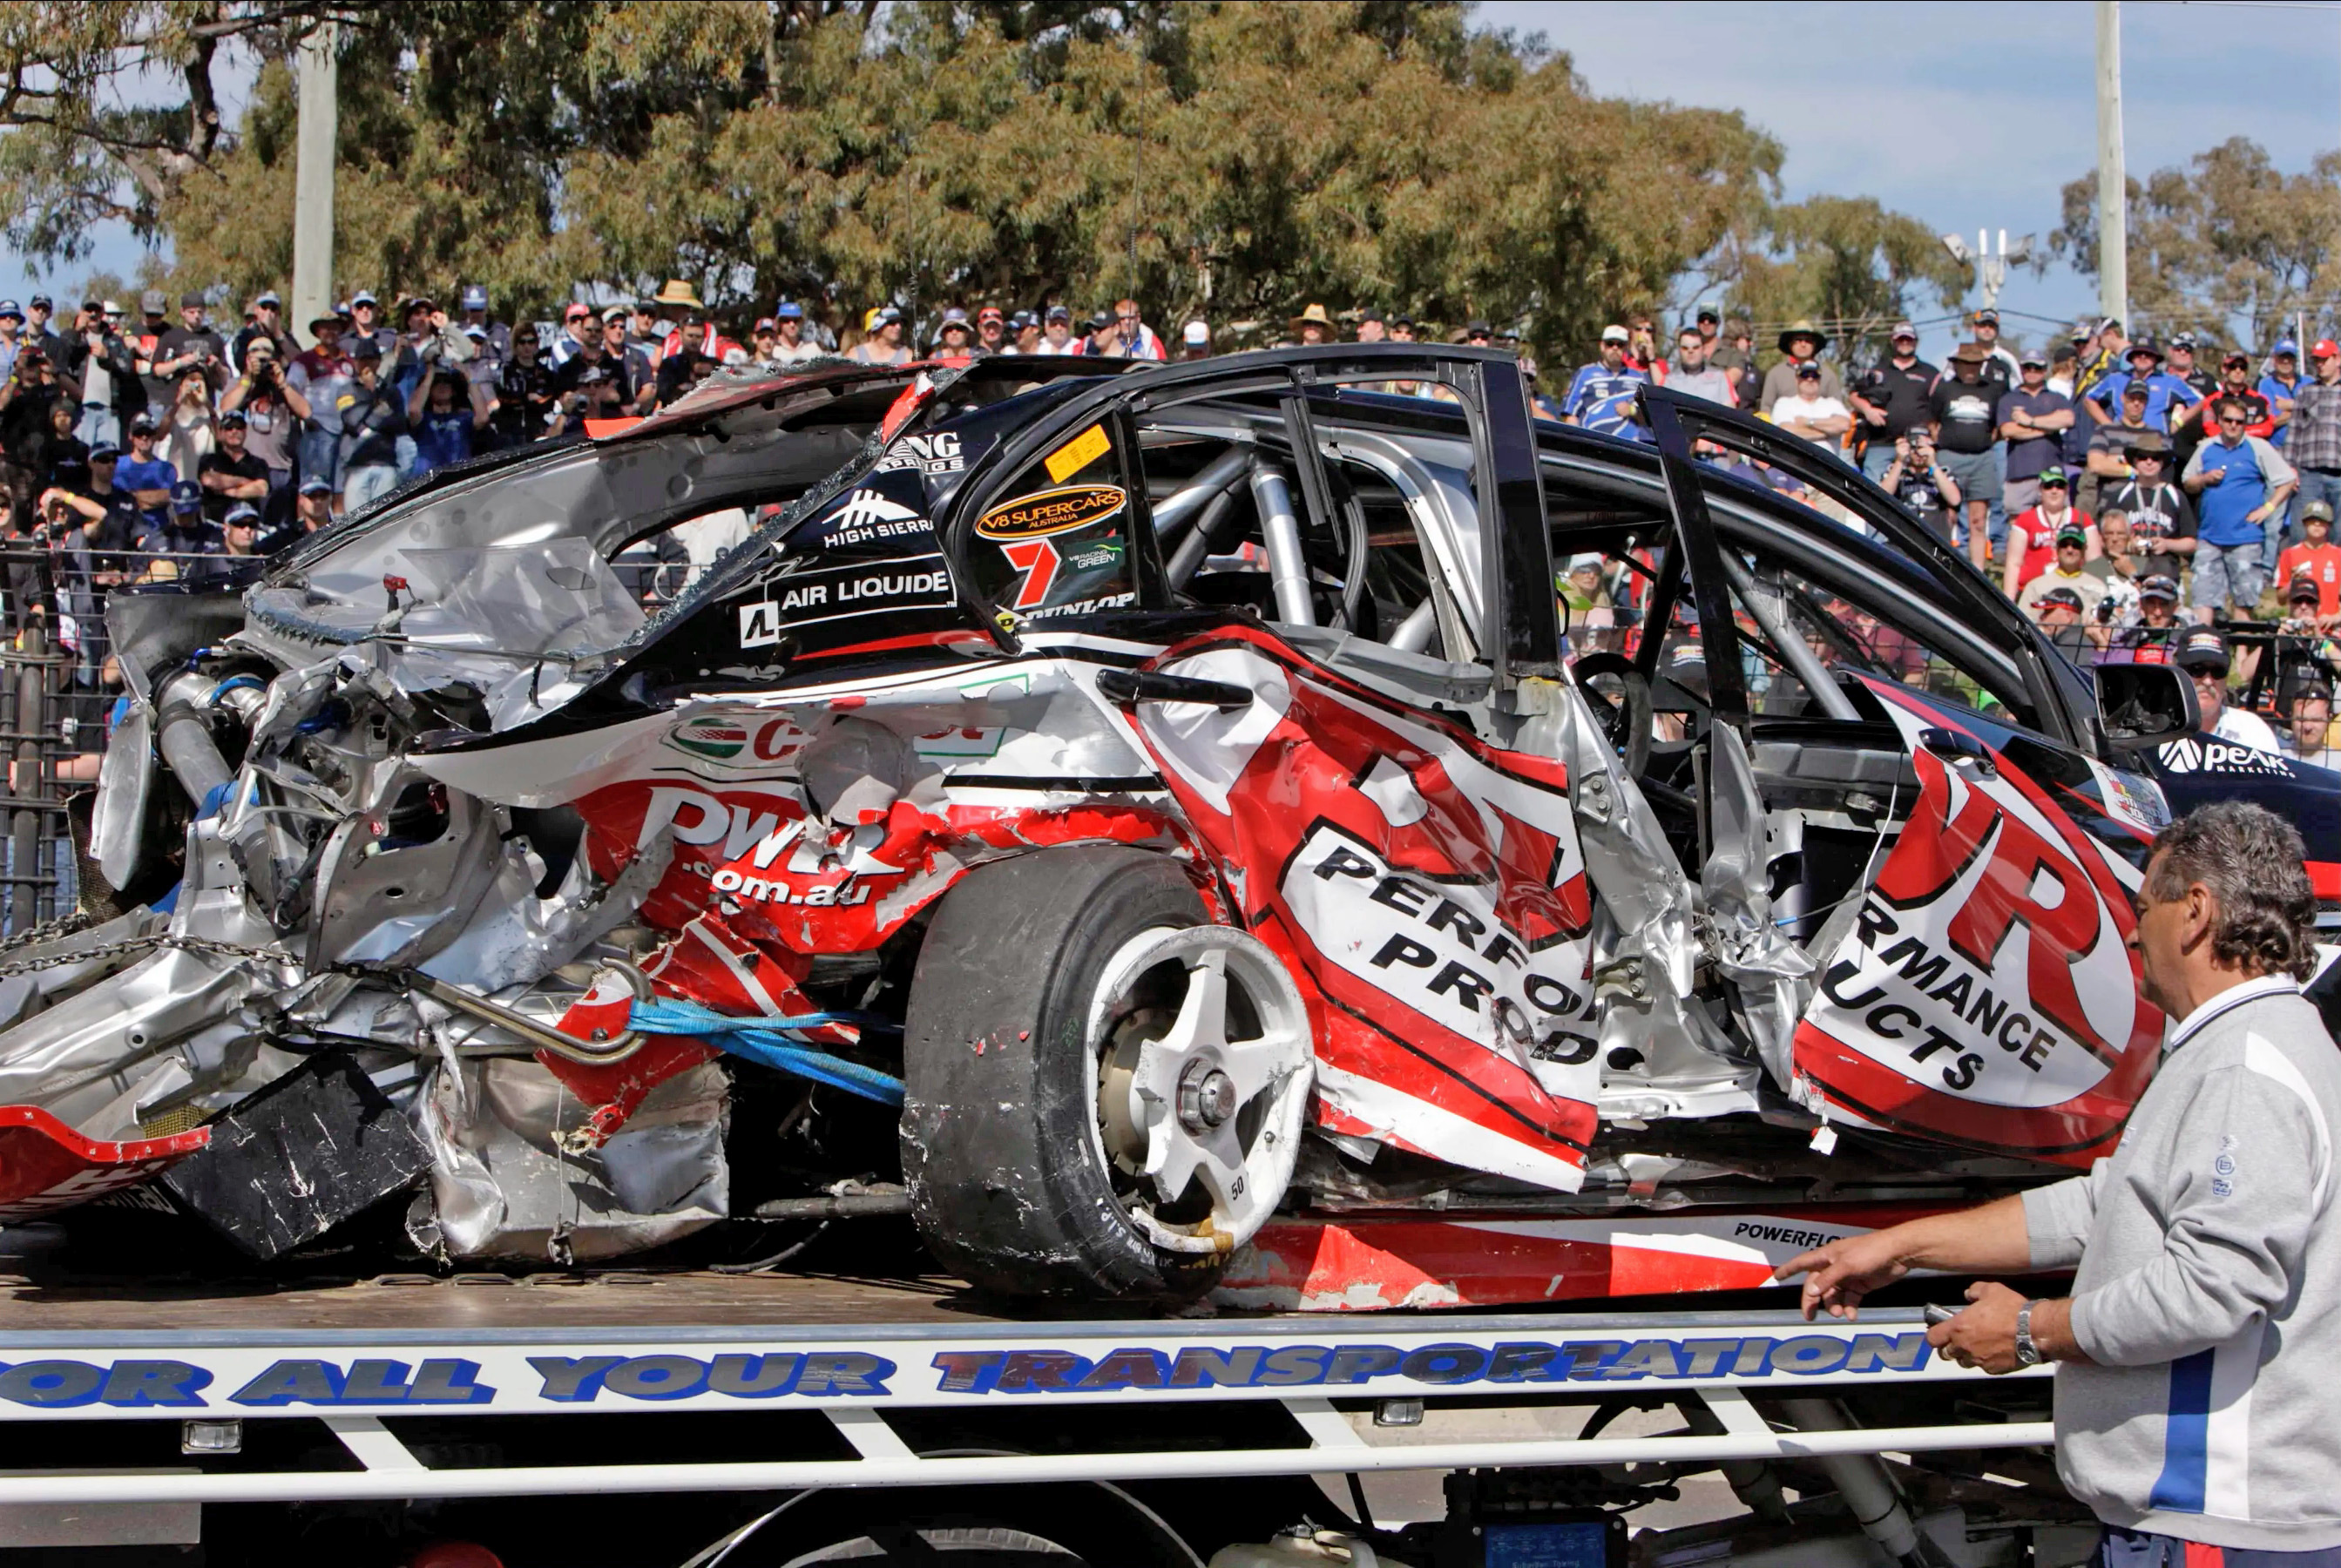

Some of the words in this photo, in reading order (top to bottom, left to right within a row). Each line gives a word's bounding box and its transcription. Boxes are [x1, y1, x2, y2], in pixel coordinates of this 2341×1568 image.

[983, 514, 1010, 530] V8
[1012, 490, 1121, 524] SUPERCARS
[1028, 512, 1078, 529] AUSTRALIA
[823, 527, 875, 549] HIGH
[1077, 552, 1115, 570] GREEN
[1079, 548, 1108, 560] RACING
[998, 537, 1062, 612] 7
[781, 585, 828, 611] AIR
[838, 571, 950, 601] LIQUIDE
[2216, 765, 2297, 779] MARKETING
[1369, 932, 1600, 1065] PROD
[1819, 959, 1986, 1092] UCTS
[1231, 1175, 1245, 1201] 50
[0, 1359, 214, 1409] OR
[227, 1358, 497, 1407] ALL
[525, 1351, 898, 1402] YOUR
[930, 1332, 1933, 1396] TRANSPORTATION
